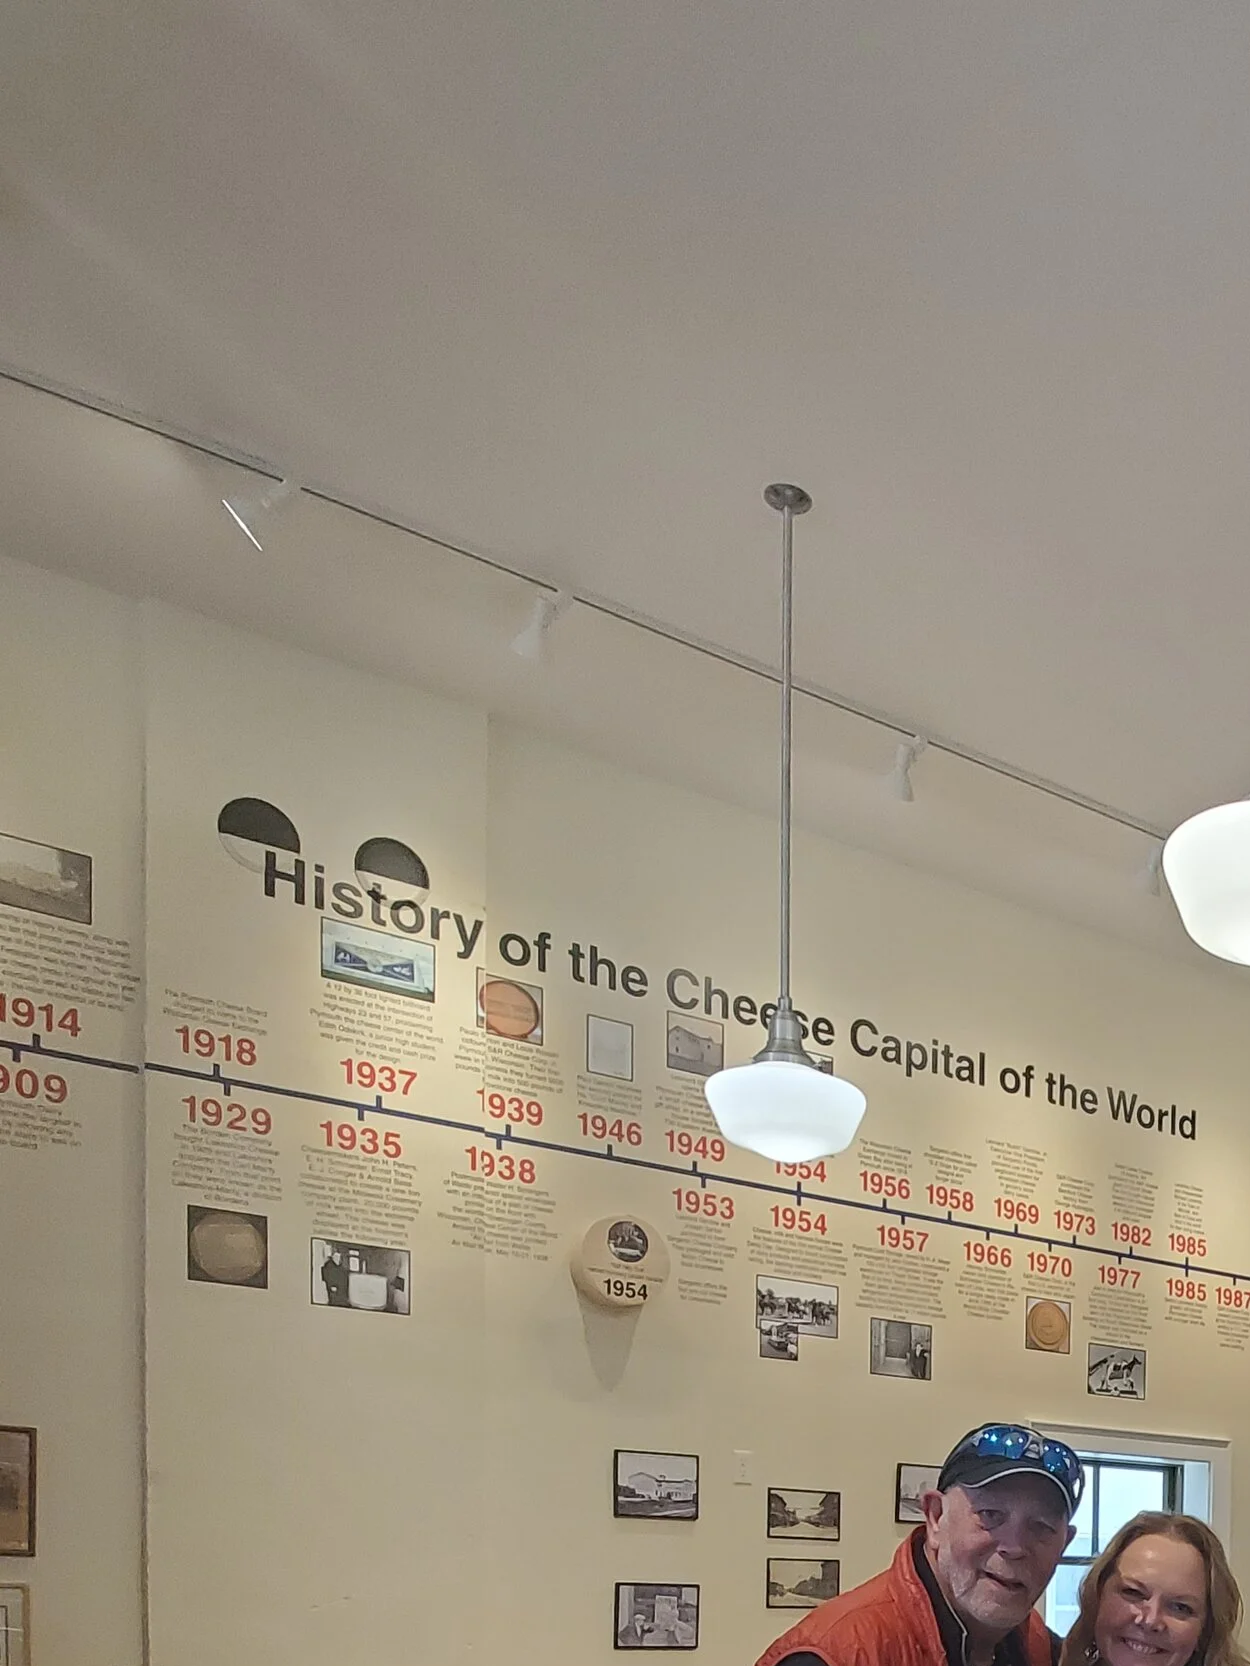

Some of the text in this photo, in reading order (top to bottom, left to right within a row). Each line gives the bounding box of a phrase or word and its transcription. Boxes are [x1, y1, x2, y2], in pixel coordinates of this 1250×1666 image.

[264, 851, 1197, 1141] History of the Cheese Capital of the World
[0, 992, 81, 1037] 1914
[175, 1025, 257, 1066] 1918
[339, 1058, 418, 1096] 1937
[182, 1096, 273, 1135] 1929
[475, 1088, 544, 1128] 1939
[319, 1120, 402, 1159] 1935
[577, 1111, 642, 1146] 1946
[664, 1130, 726, 1163] 1949
[464, 1145, 537, 1185] 1938
[775, 1161, 828, 1183] 1954
[859, 1170, 911, 1200] 1956
[925, 1183, 974, 1212] 1958
[672, 1187, 735, 1221] 1953
[994, 1197, 1040, 1225] 1969
[770, 1205, 828, 1236] 1954
[1053, 1210, 1097, 1236] 1973
[1111, 1222, 1152, 1247] 1982
[876, 1224, 929, 1253] 1957
[1168, 1233, 1207, 1257] 1985
[963, 1240, 1013, 1268] 1966
[1027, 1250, 1073, 1279] 1970
[602, 1277, 648, 1301] 1954
[1098, 1265, 1142, 1289] 1977
[1166, 1278, 1207, 1302] 1985
